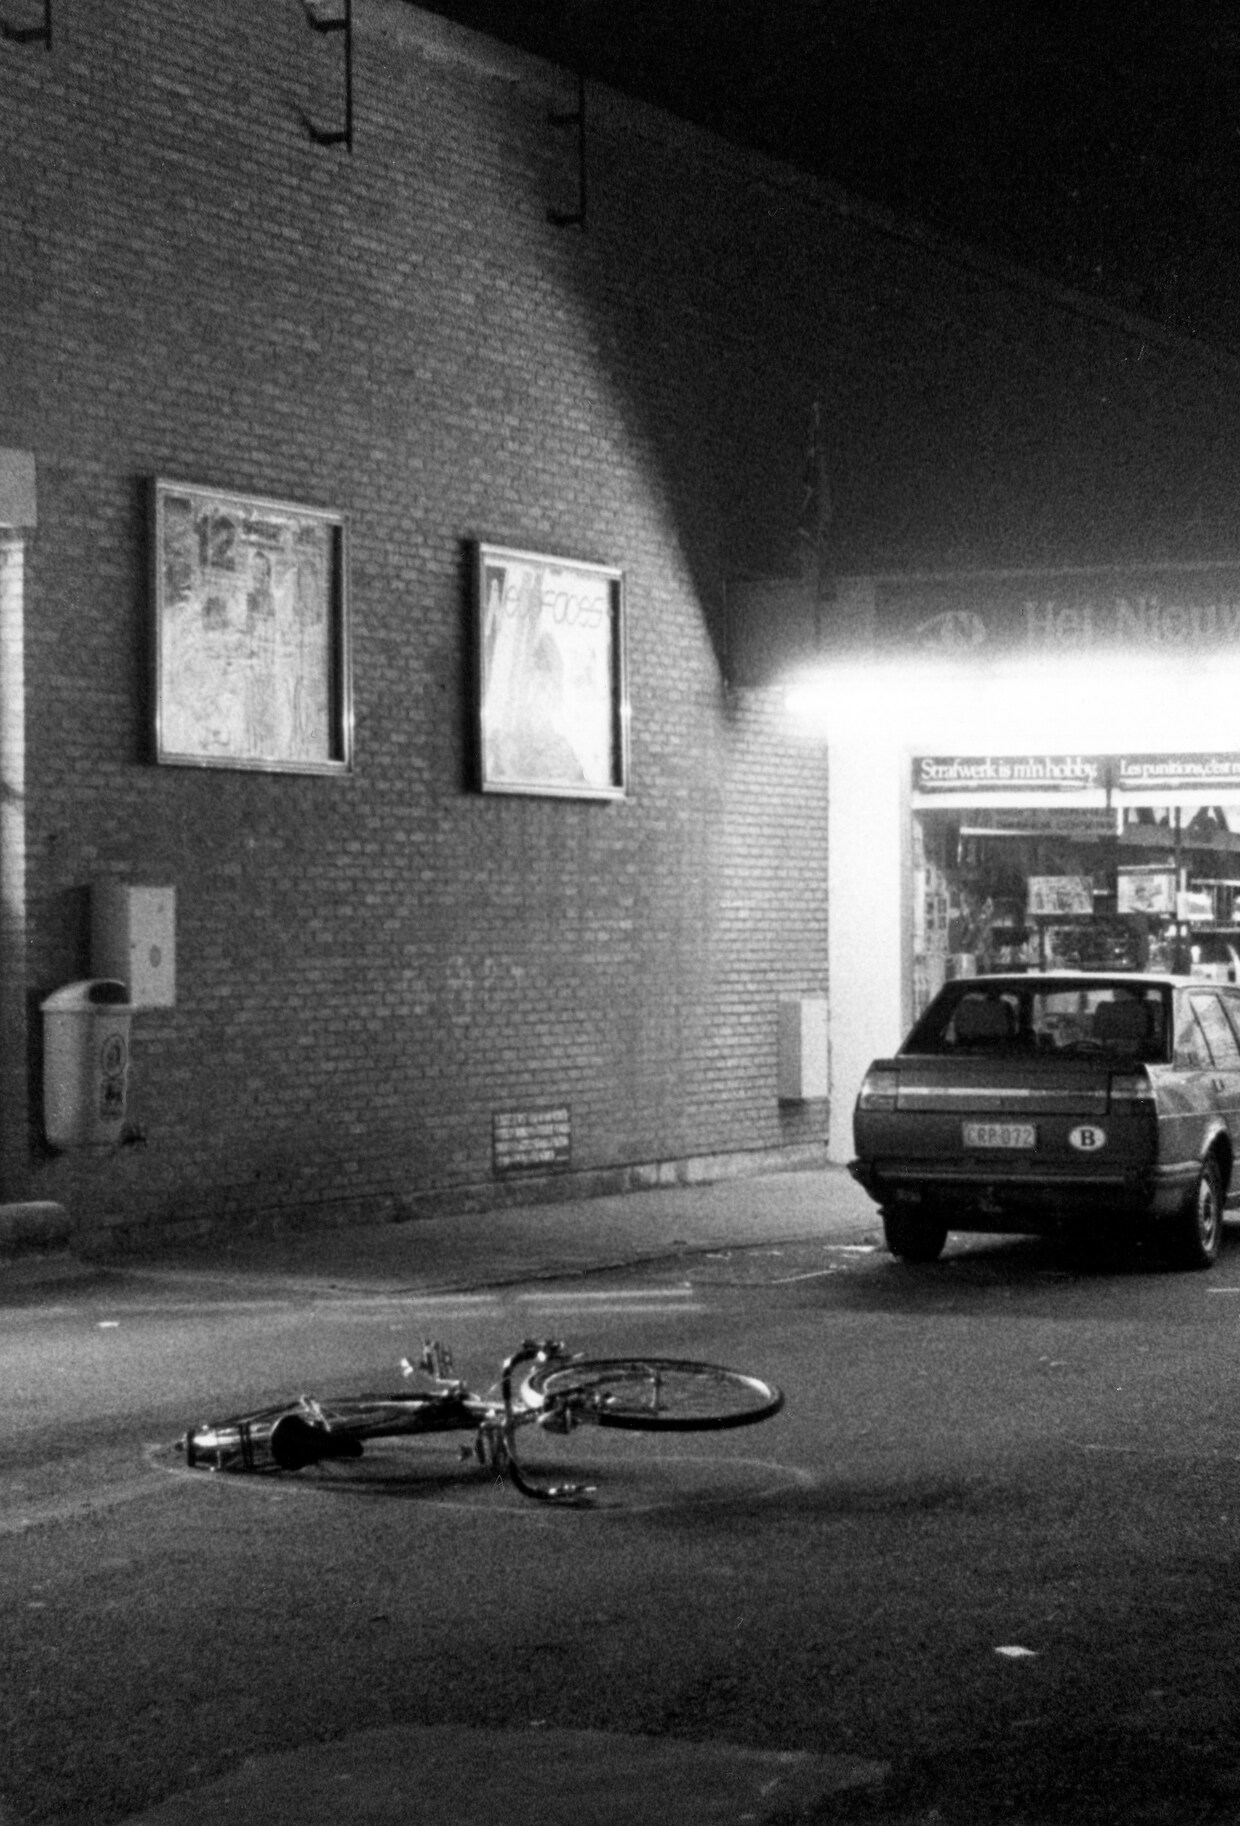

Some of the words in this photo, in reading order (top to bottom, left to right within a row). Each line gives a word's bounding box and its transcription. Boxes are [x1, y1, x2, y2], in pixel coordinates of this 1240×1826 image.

[1023, 598, 1095, 643] Het
[921, 757, 996, 780] Strafwerk
[998, 759, 1011, 778] is
[1120, 758, 1141, 775] Les
[1079, 1128, 1096, 1147] B
